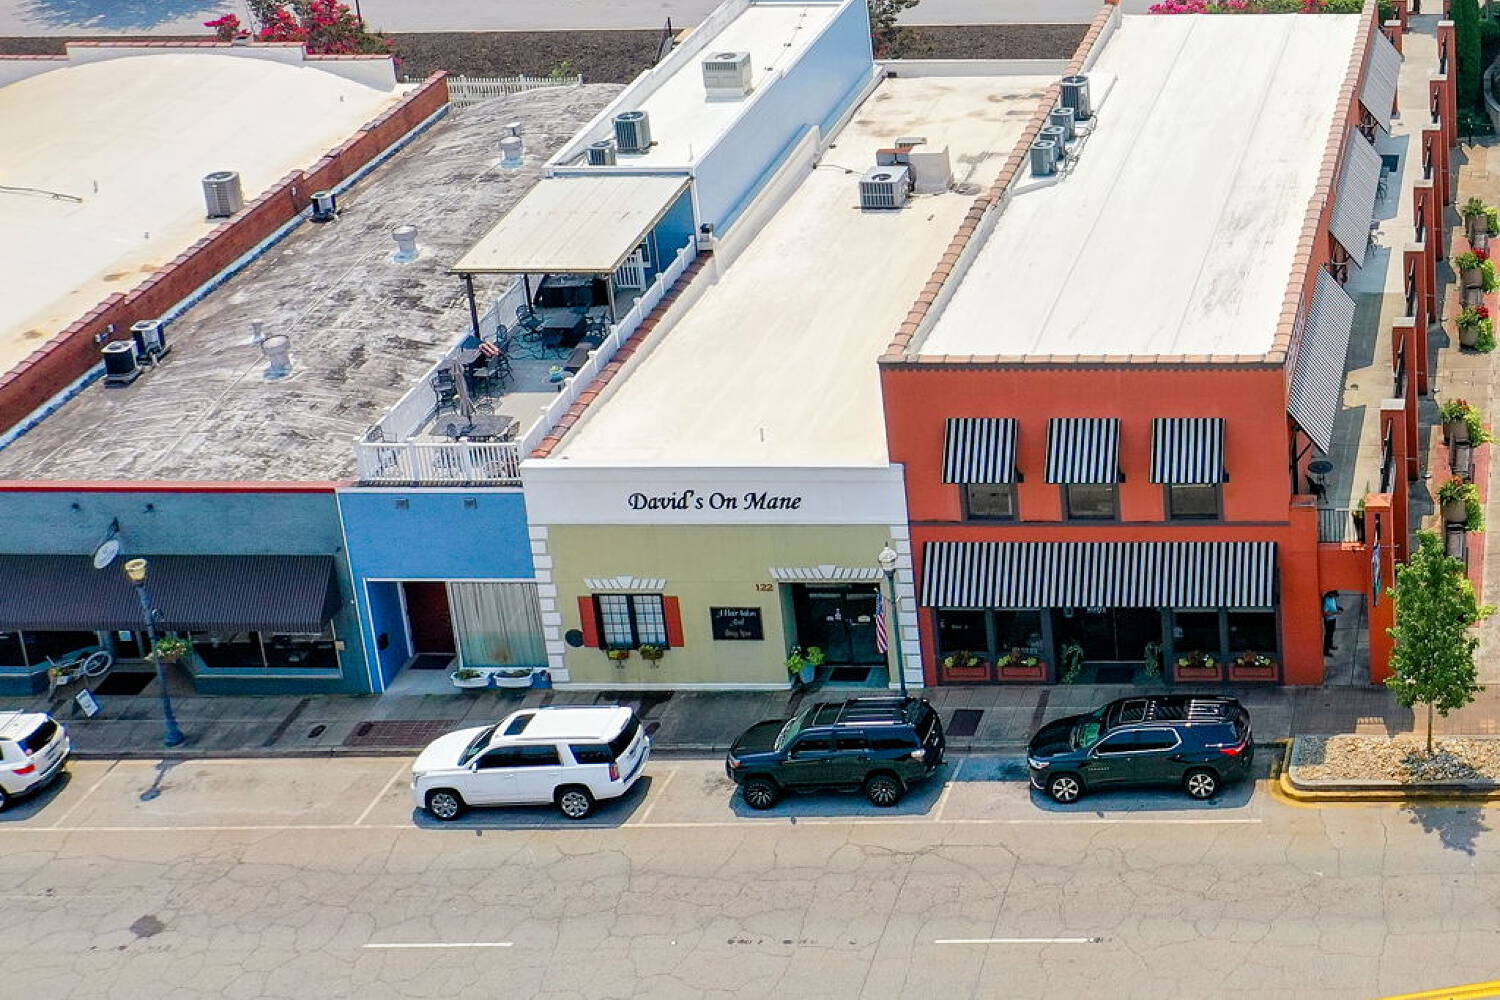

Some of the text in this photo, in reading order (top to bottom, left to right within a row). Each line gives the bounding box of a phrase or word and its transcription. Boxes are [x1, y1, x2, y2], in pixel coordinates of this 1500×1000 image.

[628, 490, 802, 510] David's On Mane
[755, 583, 774, 592] 122
